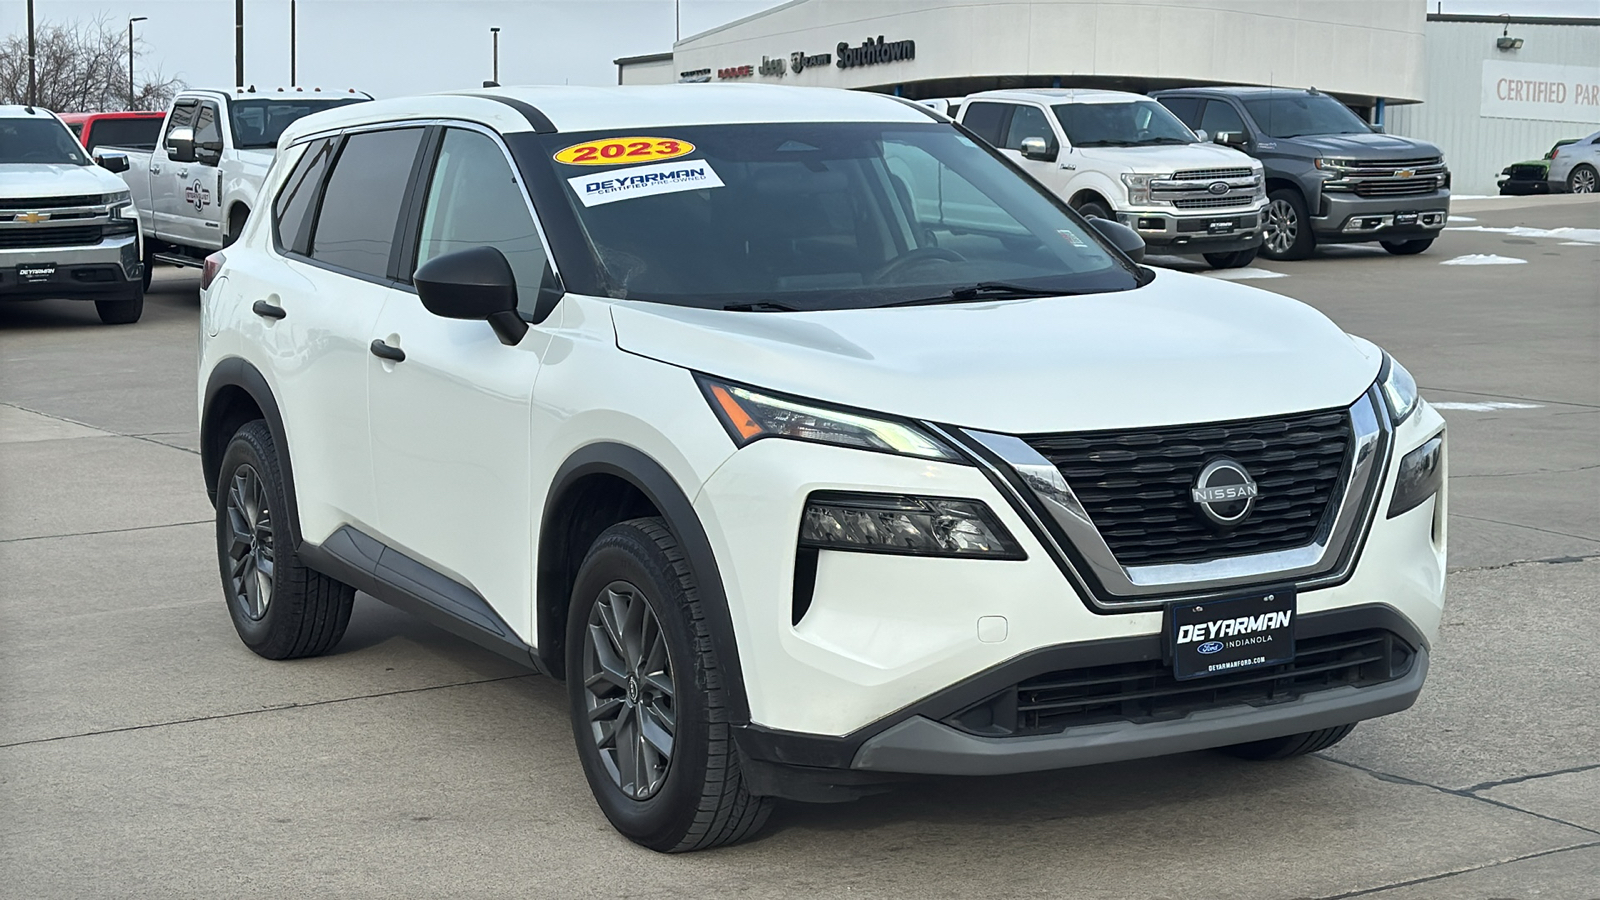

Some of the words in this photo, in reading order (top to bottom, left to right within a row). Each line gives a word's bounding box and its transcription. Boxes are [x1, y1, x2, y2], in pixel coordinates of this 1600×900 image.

[758, 55, 787, 78] Jeep
[836, 35, 915, 69] Southtown
[1496, 78, 1567, 104] CERTIFIED
[572, 141, 682, 162] 2023
[585, 168, 705, 193] DEYARMAN
[597, 183, 648, 195] CERTIFIED
[650, 175, 707, 186] PRE-OWNED
[1195, 485, 1257, 501] NISSAN
[1176, 610, 1292, 644] DEYARMAN
[1200, 642, 1221, 653] Ford
[1226, 635, 1273, 648] INDIANOLA
[1208, 656, 1266, 672] DEYARMANFORD.COM
